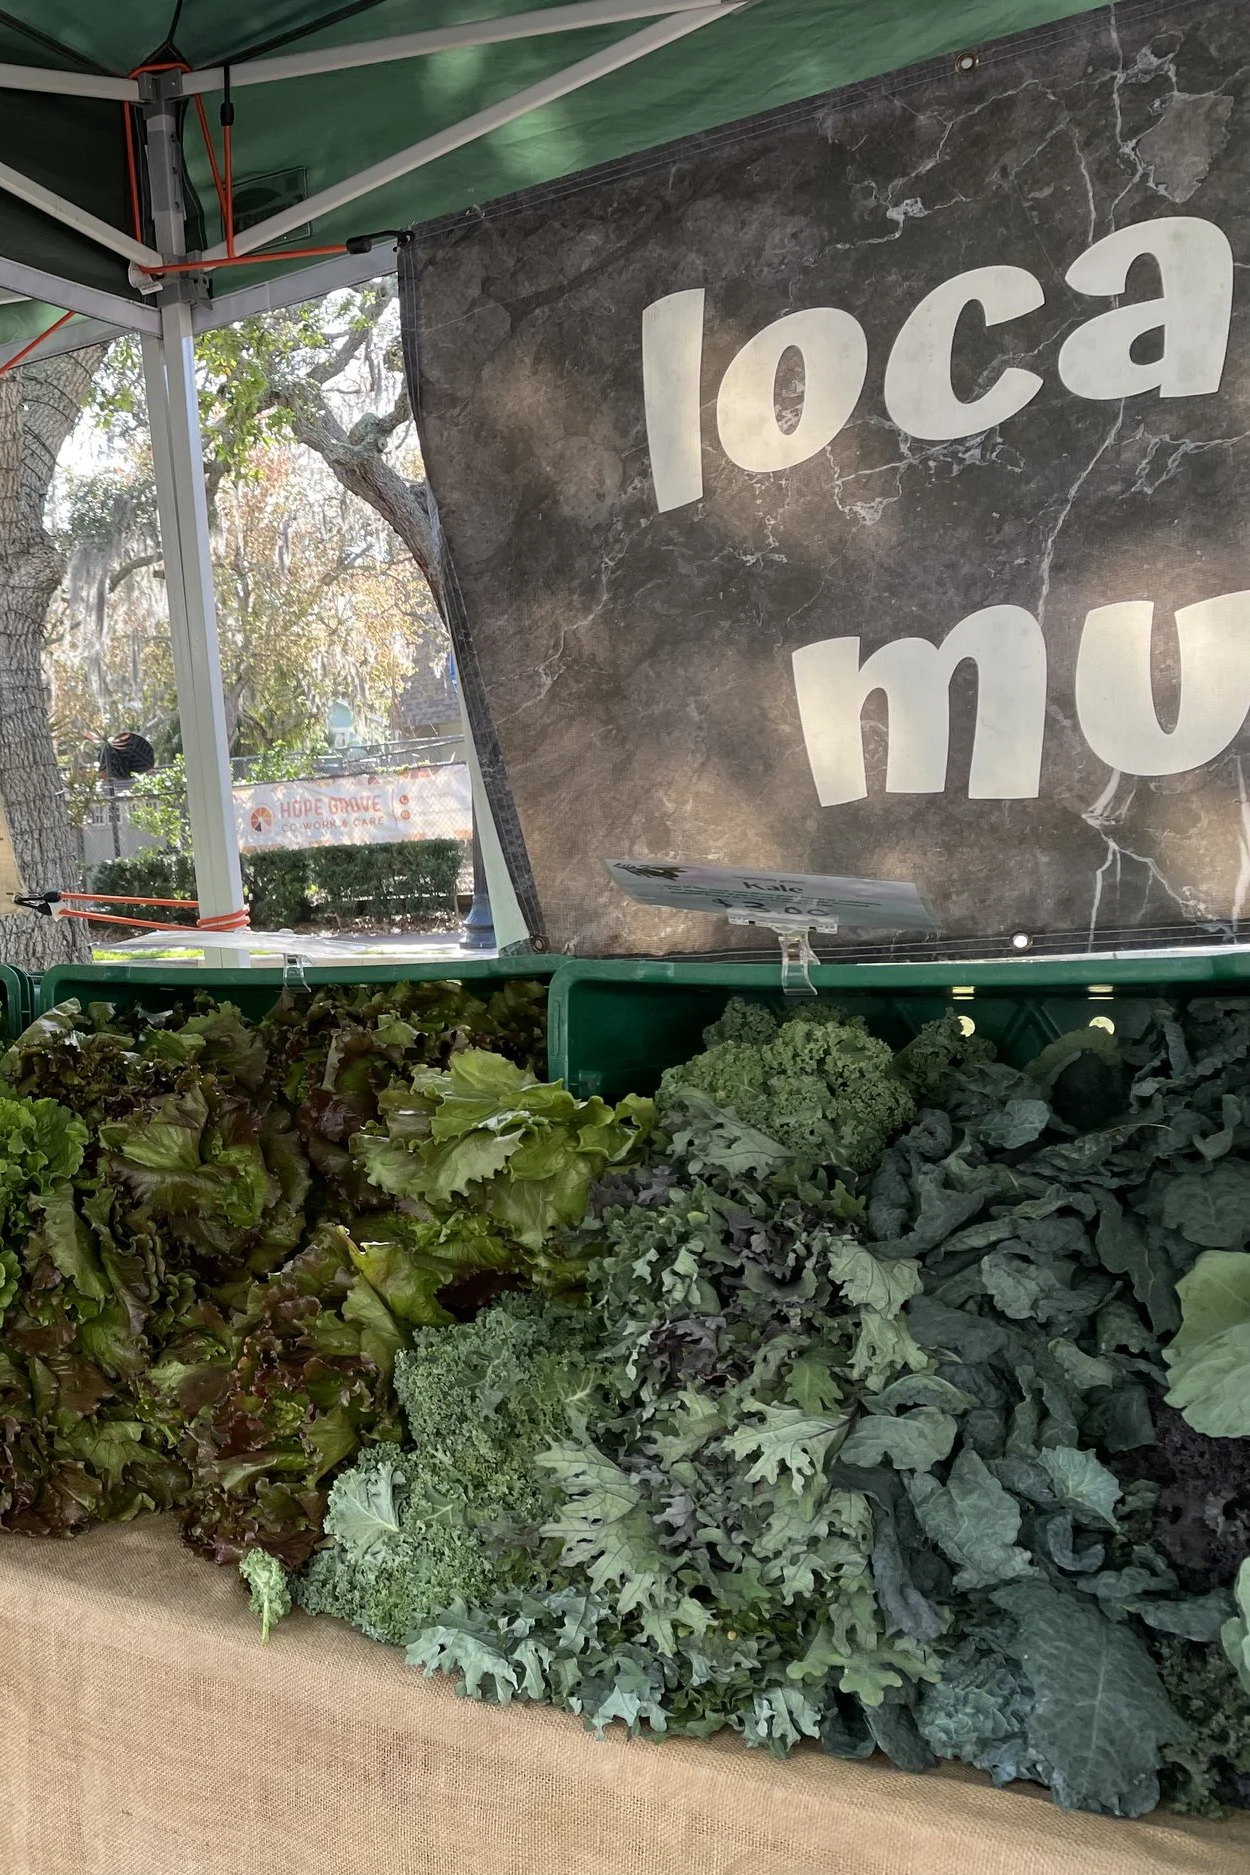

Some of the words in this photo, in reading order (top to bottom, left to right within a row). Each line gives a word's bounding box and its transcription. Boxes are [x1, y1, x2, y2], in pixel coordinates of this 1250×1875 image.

[642, 216, 1234, 513] loca
[280, 799, 324, 818] HOPE
[328, 795, 382, 814] GROVE
[282, 820, 336, 833] CO-WORK
[341, 819, 348, 828] &
[353, 816, 385, 827] CARE
[743, 881, 804, 893] Kale
